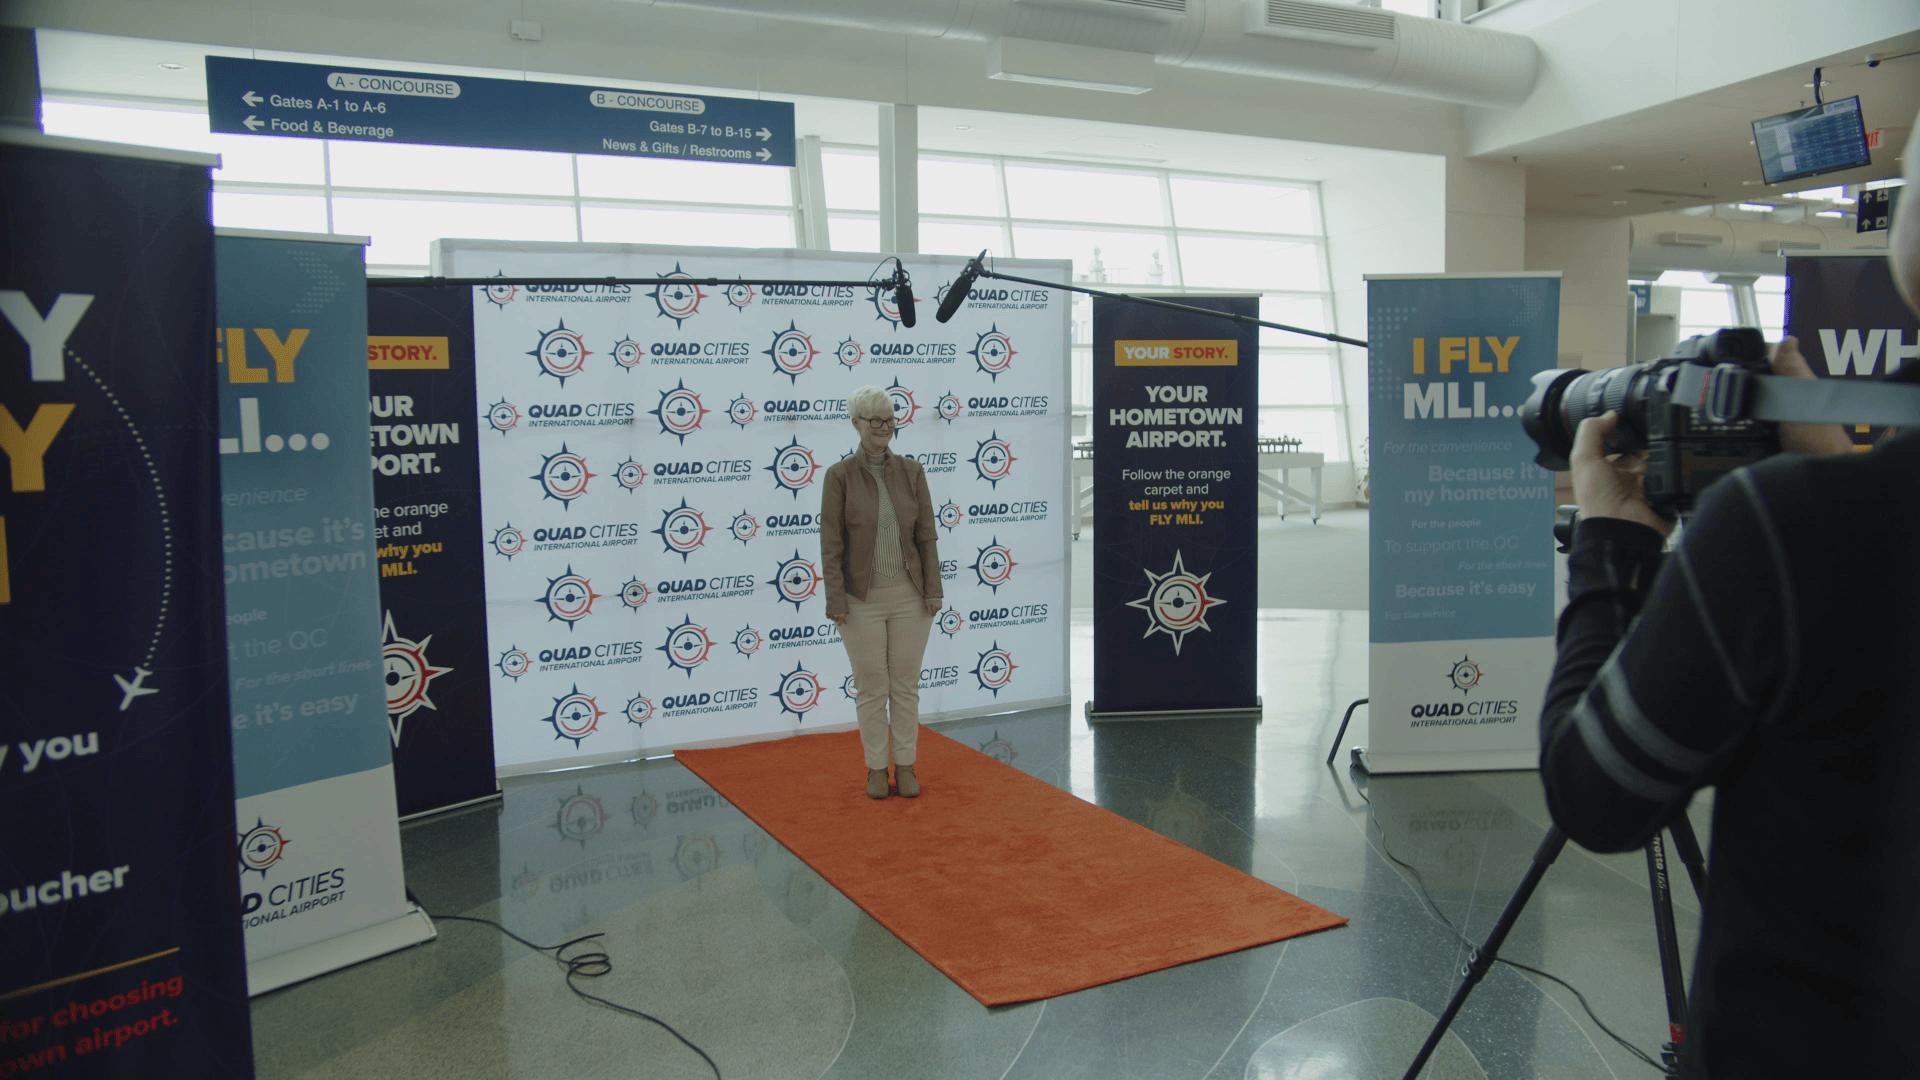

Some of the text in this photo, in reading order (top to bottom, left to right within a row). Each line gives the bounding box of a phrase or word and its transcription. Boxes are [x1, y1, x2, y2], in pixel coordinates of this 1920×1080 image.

[335, 76, 453, 95] A CONCOURSE
[270, 94, 386, 113] Gates A-1 to A-6
[597, 94, 699, 111] B CONCOURSE
[271, 119, 394, 139] Food & Beverage
[650, 121, 751, 138] Gates B-7 to B-15
[603, 138, 751, 158] News & Gifts Restrooms
[762, 285, 854, 298] QUAD CITIES
[968, 289, 1048, 301] QUAD CITIES
[368, 345, 437, 361] STORY.
[651, 343, 749, 356] QUAD CITIES
[870, 343, 956, 355] QUAD CITIES
[1124, 346, 1228, 360] YOUR STORY.
[1413, 336, 1520, 374] I FLY
[1145, 385, 1208, 403] YOUR
[528, 403, 634, 418] QUAD CITIES
[764, 400, 810, 413] QUAD
[968, 396, 1048, 409] QUAD CITIES
[598, 418, 634, 426] AIRPORT
[1110, 408, 1243, 425] HOMETOWN
[1126, 430, 1227, 448] AIRPORT.
[1384, 440, 1512, 454] For the convenience
[918, 453, 957, 465] CITIES
[654, 460, 752, 476] QUAD CITIES
[1122, 469, 1231, 481] Follow the orange
[1429, 465, 1514, 481] Because
[1144, 484, 1208, 497] carpet and
[1405, 485, 1548, 506] my hometown
[394, 503, 448, 517] orange
[968, 501, 1048, 516] QUAD CITIES
[1129, 499, 1224, 512] tell us why you
[766, 514, 812, 528] QUAD
[1150, 514, 1203, 525] FLY MLI.
[1412, 519, 1481, 528] For the people
[393, 521, 422, 537] and
[533, 523, 638, 542] QUAD CITIES
[376, 542, 442, 559] why you
[534, 539, 638, 551] INTERNATIONAL AIRPORT
[1384, 536, 1519, 554] To support the QC
[382, 562, 417, 577] MLI.
[658, 575, 754, 593] QUAD CITIES
[1395, 584, 1465, 598] Because
[1497, 582, 1536, 597] easy
[658, 589, 754, 602] INTERNATIONAL AIRPORT
[969, 604, 1048, 621] QUAD CITIES
[969, 620, 1019, 629] INTERNATIONAL
[769, 626, 814, 641] QUAD
[244, 628, 328, 658] the QC
[769, 639, 826, 649] INTERNATIONAL
[539, 641, 642, 662] QUAD CITIES
[540, 656, 642, 671] INTERNATIONAL AIRPORT
[236, 660, 371, 691] For the short lines
[921, 666, 958, 680] CITIES
[930, 679, 958, 688] AIRPORT
[301, 693, 358, 717] easy
[662, 688, 758, 709] QUAD CITIES
[663, 702, 757, 718] INTERNATIONAL AIRPORT
[1411, 701, 1518, 718] QUAD CITIES
[1411, 719, 1478, 727] INTERNATIONAL
[19, 732, 99, 773] you
[269, 868, 344, 906] CITIES
[289, 891, 345, 916] AIRPORT
[52, 975, 183, 1028] choosing
[75, 1008, 179, 1055] airport.
